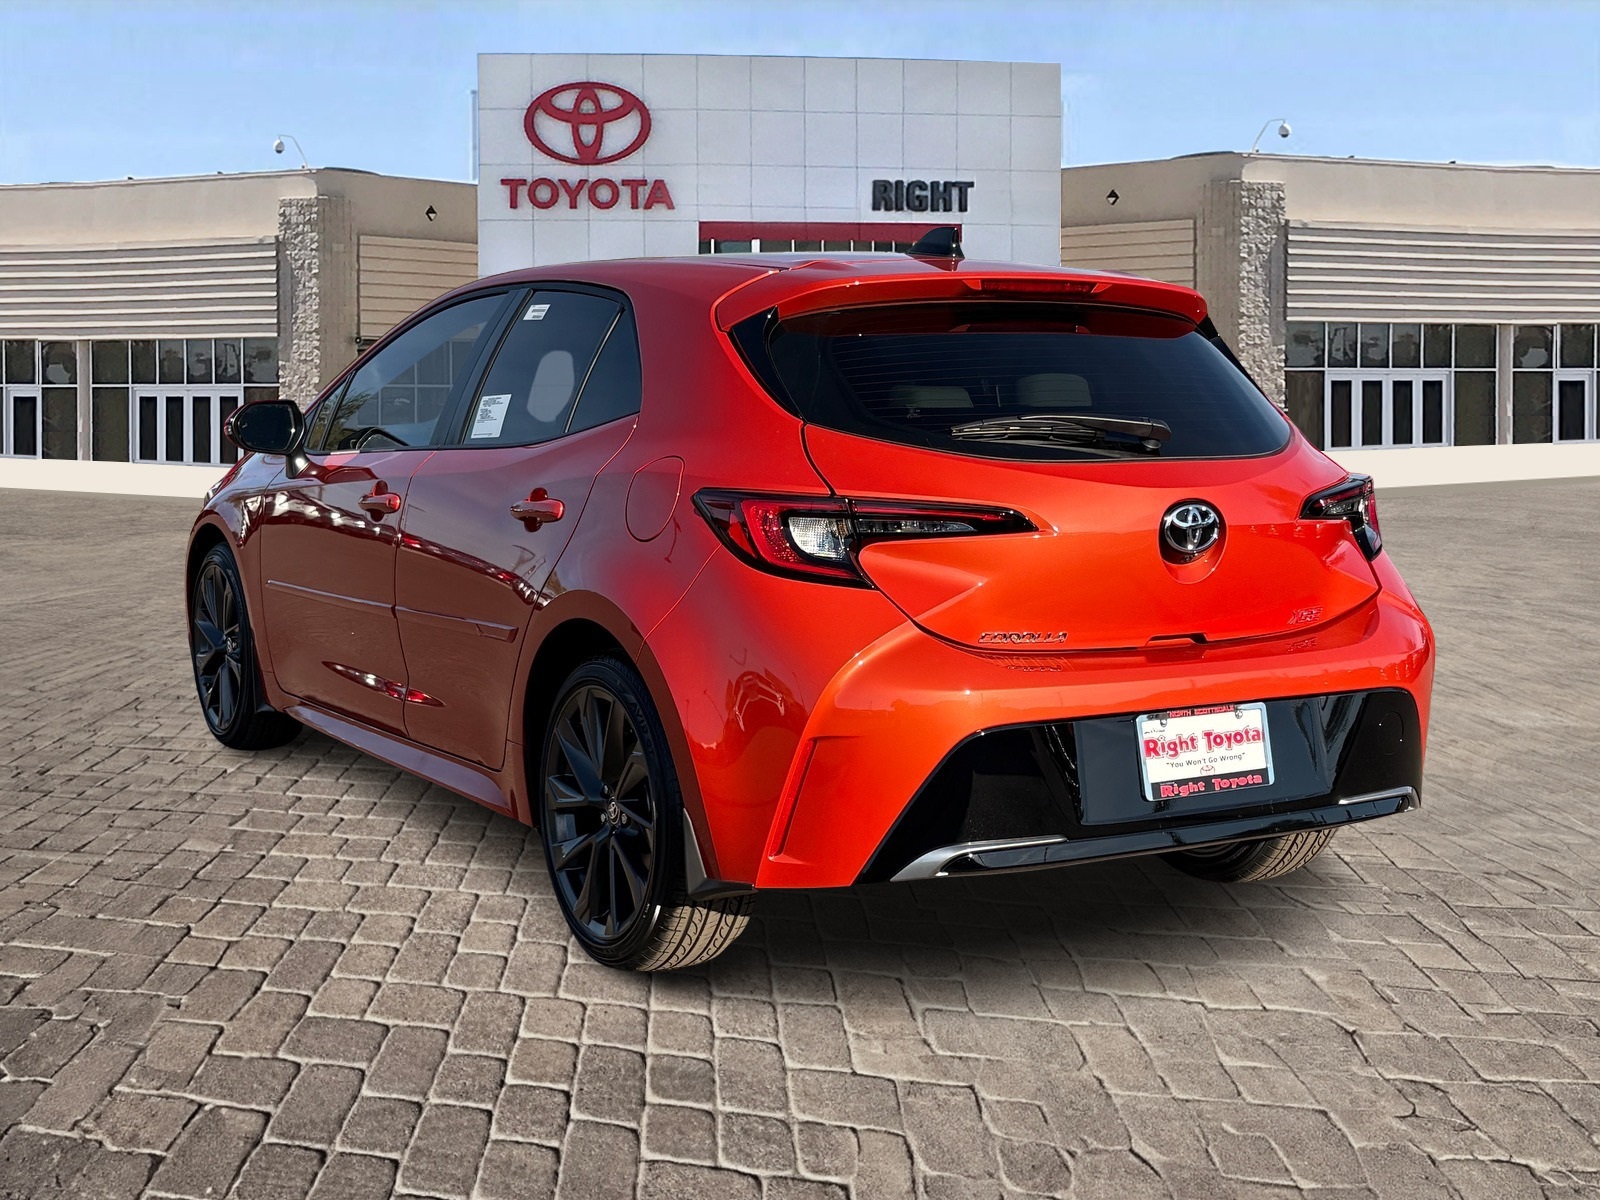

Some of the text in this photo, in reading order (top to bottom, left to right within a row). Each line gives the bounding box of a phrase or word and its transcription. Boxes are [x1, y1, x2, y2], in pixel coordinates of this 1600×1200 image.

[500, 178, 675, 210] TOYOTA
[871, 180, 975, 213] RIGHT
[978, 632, 1068, 644] COROLLA
[1143, 727, 1262, 759] Right Toyota
[1186, 758, 1207, 766] Won't
[1219, 752, 1246, 762] Wrong"
[1160, 774, 1263, 797] Right Toyota
